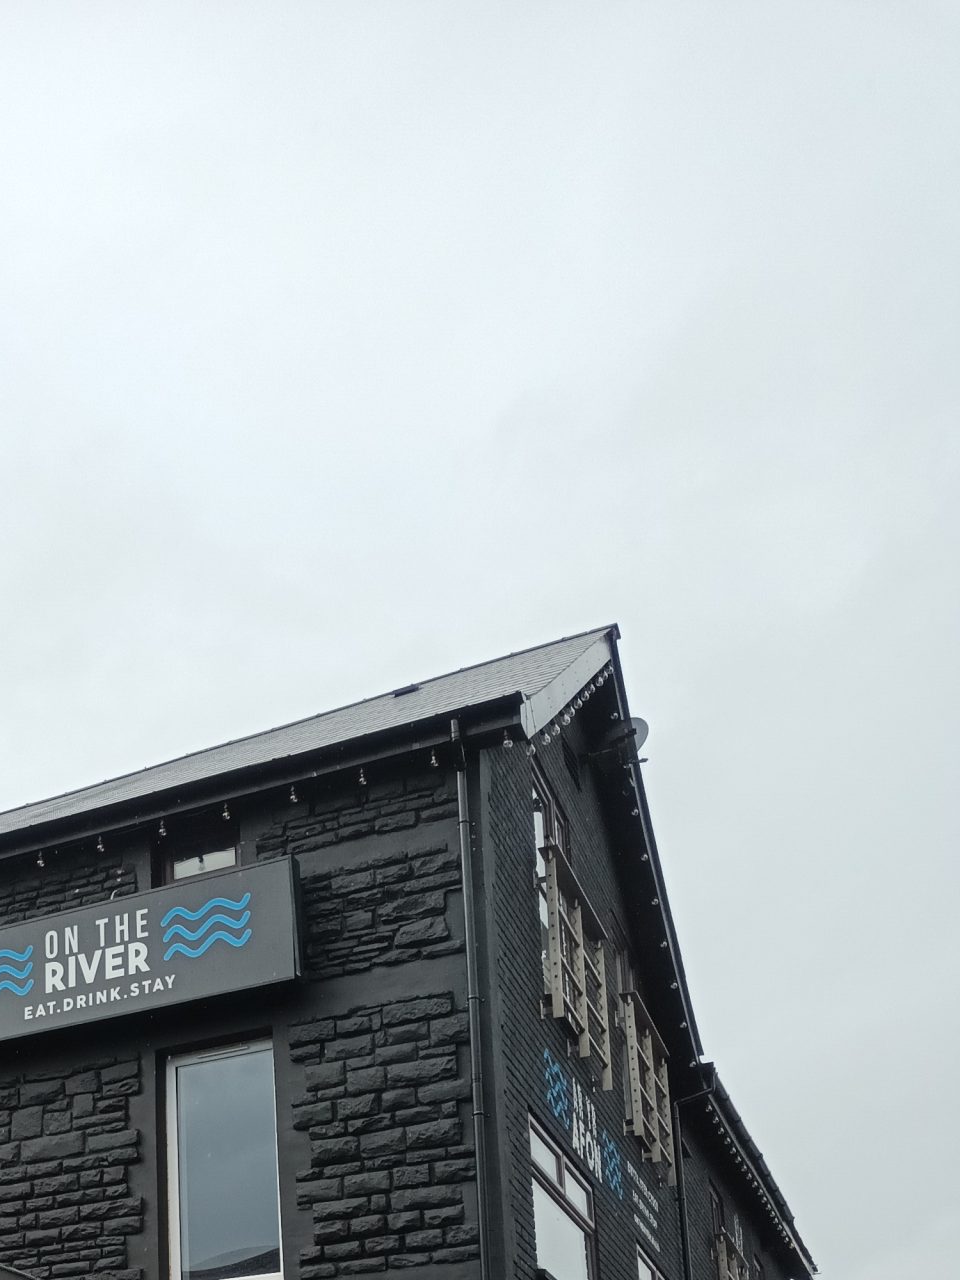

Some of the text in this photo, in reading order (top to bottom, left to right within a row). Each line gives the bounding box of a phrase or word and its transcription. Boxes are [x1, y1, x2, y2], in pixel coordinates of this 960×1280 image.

[45, 908, 149, 959] ON THE
[44, 941, 151, 994] RIVER
[24, 974, 176, 1020] EAT.DRINK.STAY
[572, 1111, 603, 1183] AFON
